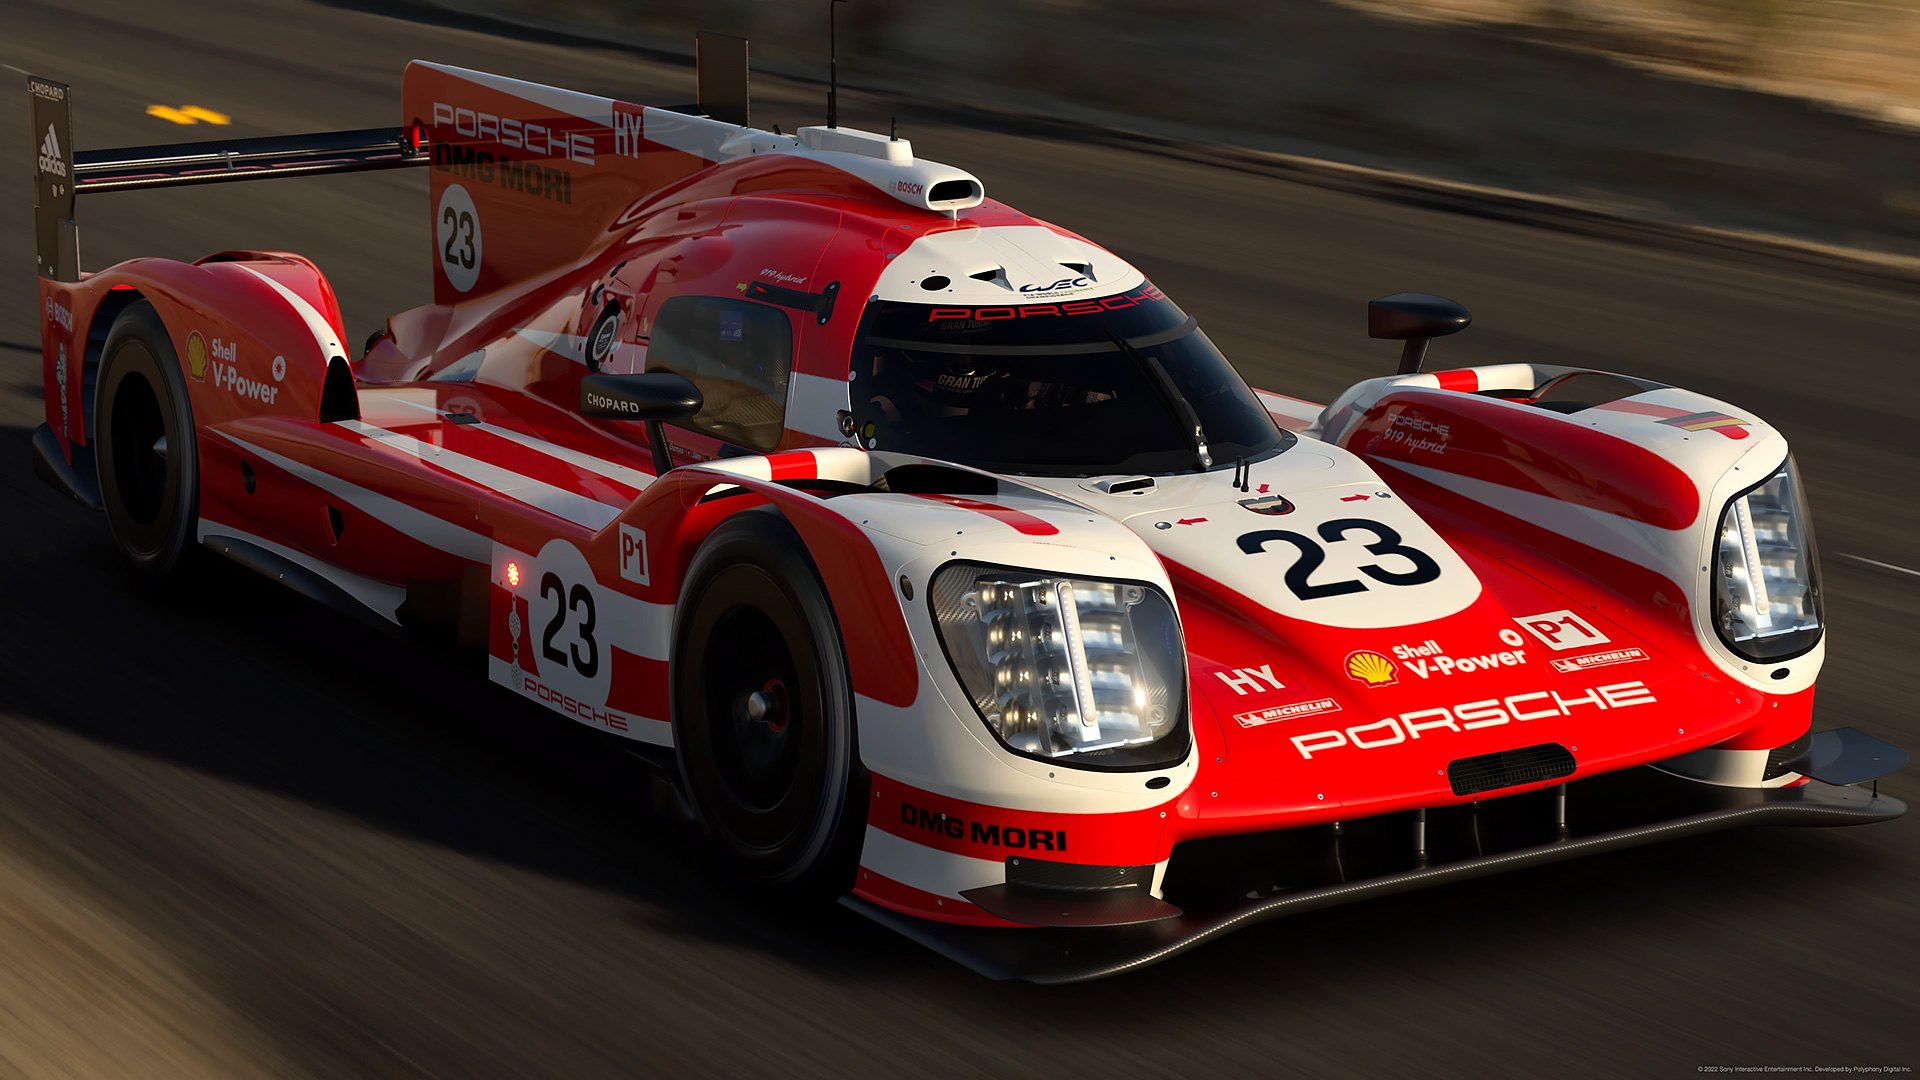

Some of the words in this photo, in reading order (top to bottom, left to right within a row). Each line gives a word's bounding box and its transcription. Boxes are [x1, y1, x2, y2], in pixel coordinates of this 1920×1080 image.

[30, 81, 64, 100] CHOPARD
[433, 102, 596, 166] PORSCHE
[613, 110, 642, 159] HY
[39, 155, 67, 177] adidas
[434, 140, 495, 184] DMG
[500, 157, 573, 208] MORI
[896, 180, 924, 196] BOSCH
[442, 206, 477, 271] 23
[774, 271, 808, 284] hybrid
[1018, 277, 1089, 293] WEC
[54, 302, 73, 333] BOSCH
[928, 285, 1167, 323] PORSCHE
[211, 338, 236, 363] Shell
[212, 360, 279, 405] V-Power
[937, 374, 971, 389] GRAN
[587, 392, 640, 413] CHOPARD
[1387, 413, 1449, 437] PORSCHE
[1383, 428, 1405, 443] 919
[1403, 433, 1448, 455] hybrid
[622, 532, 645, 576] P1
[1236, 518, 1441, 601] 23
[540, 571, 599, 679] 23
[1526, 615, 1598, 644] P1
[1392, 640, 1443, 660] Shell
[1402, 650, 1527, 680] V-Power
[1575, 649, 1642, 666] MICHELIN
[1213, 664, 1286, 696] HY
[524, 677, 629, 732] PORSCHE
[1262, 700, 1333, 720] MICHELIN
[1289, 680, 1657, 760] PORSCHE
[901, 802, 964, 839] DMG
[970, 822, 1067, 851] MORI
